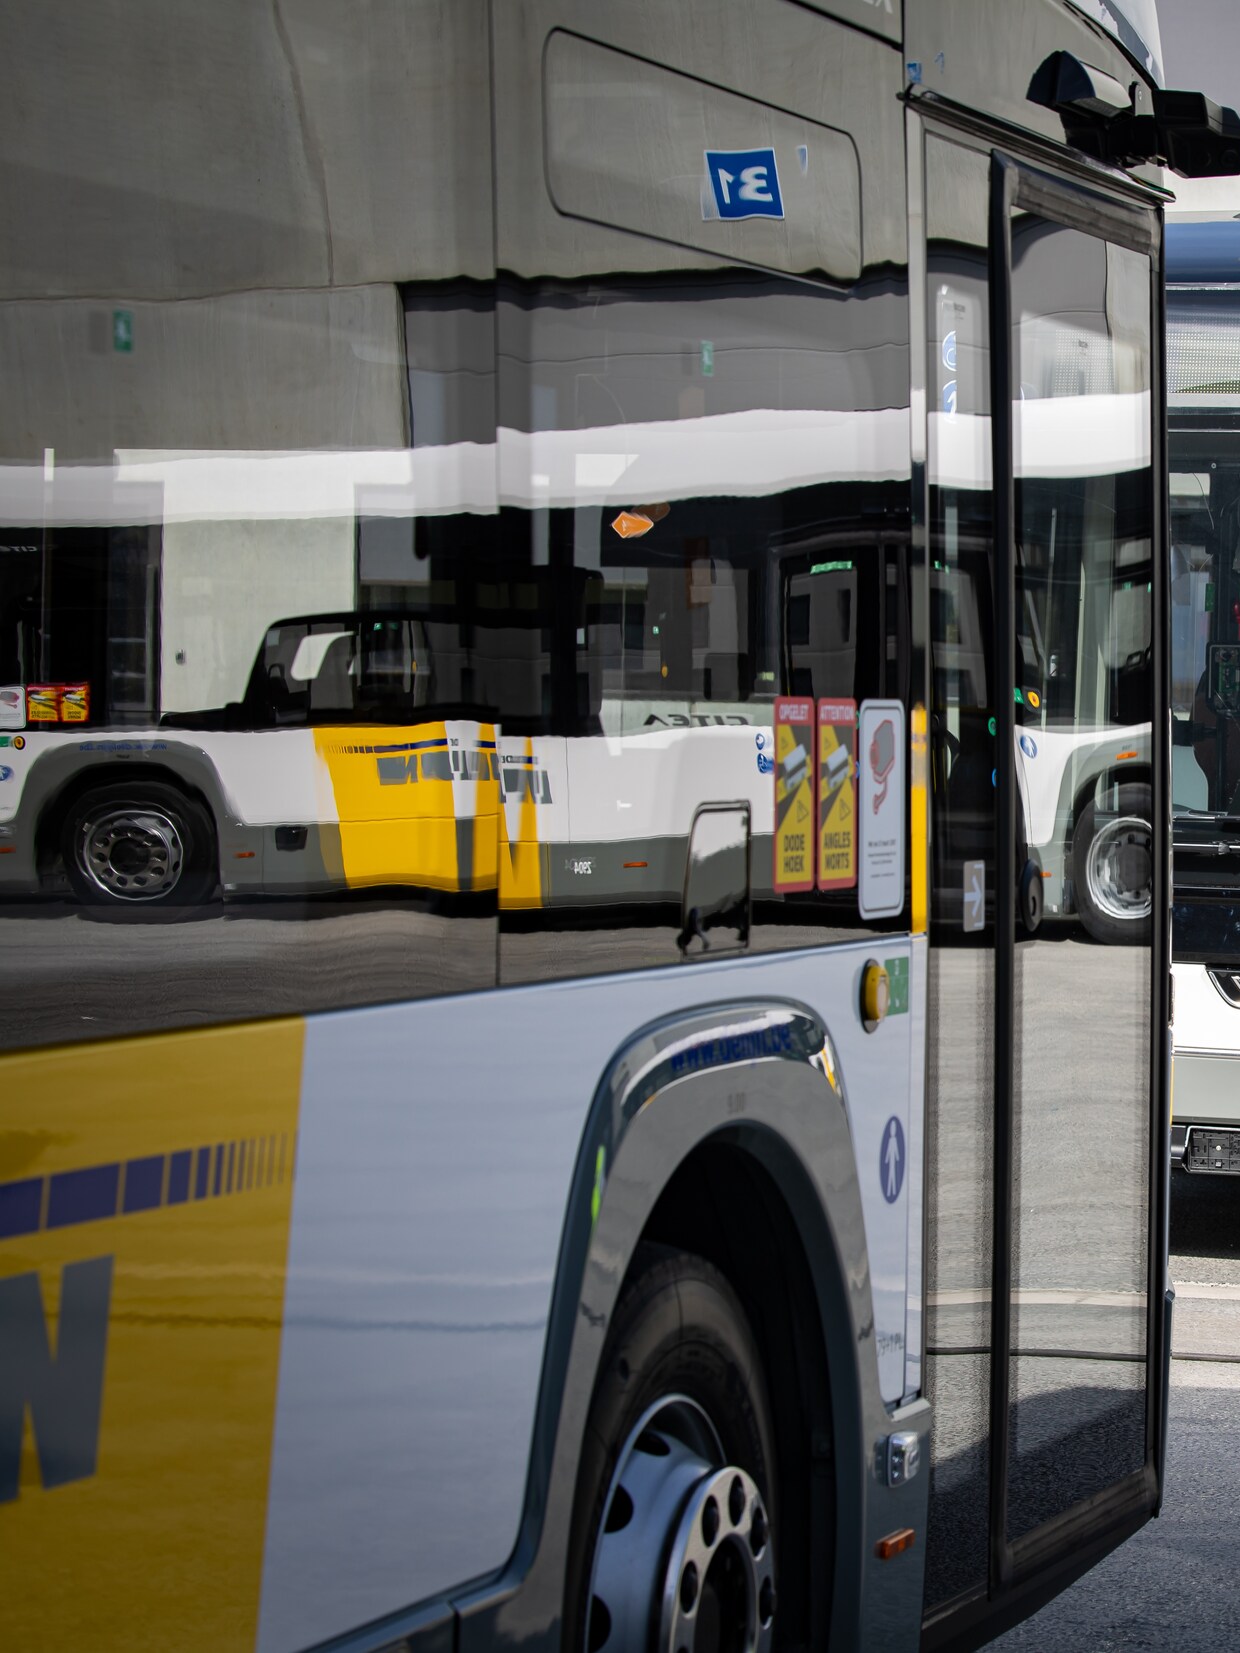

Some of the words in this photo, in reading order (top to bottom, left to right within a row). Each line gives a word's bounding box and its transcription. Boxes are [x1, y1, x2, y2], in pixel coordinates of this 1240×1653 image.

[778, 703, 809, 721] OPGELET
[819, 704, 855, 721] ATTENTION
[783, 834, 805, 852] DODE
[824, 831, 851, 849] ANGLES
[783, 854, 805, 873] HOEK
[824, 852, 850, 871] MORTS
